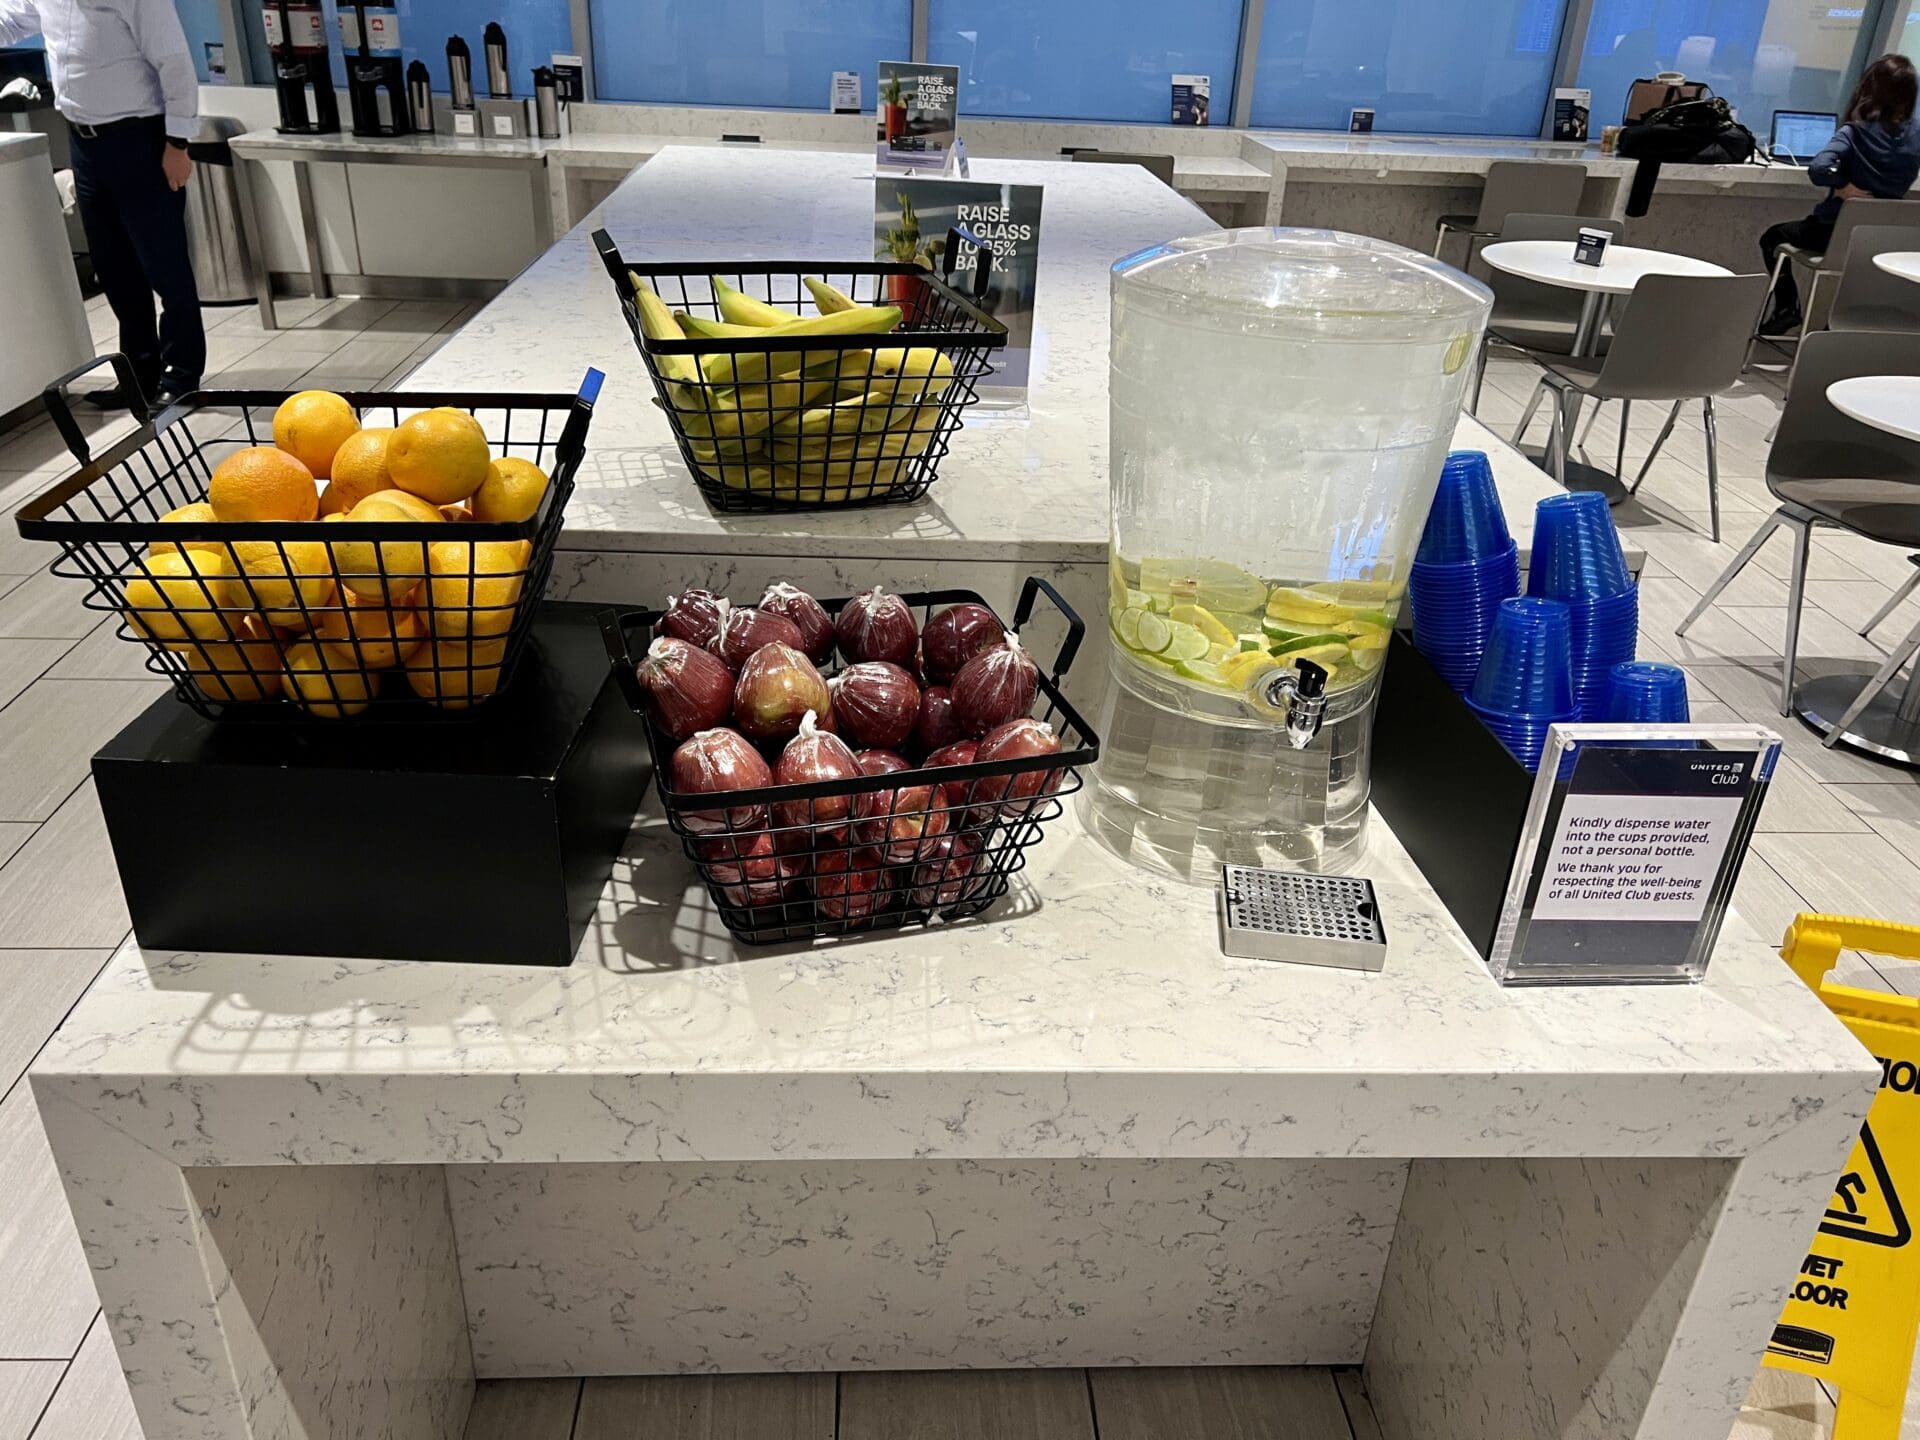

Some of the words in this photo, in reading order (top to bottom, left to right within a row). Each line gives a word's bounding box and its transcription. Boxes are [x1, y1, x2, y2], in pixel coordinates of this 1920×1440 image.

[918, 76, 944, 85] RAISE
[918, 84, 924, 92] A
[925, 85, 954, 94] GLASS
[918, 92, 929, 101] TO
[930, 93, 948, 102] 25%
[917, 101, 944, 110] BACK.
[957, 205, 1010, 222] RAISE
[973, 223, 1031, 240] GLASS
[955, 255, 1008, 272] BAK.
[1711, 773, 1739, 784] Club
[1570, 817, 1611, 829] Kindly
[1615, 817, 1670, 829] dispense
[1674, 820, 1711, 829] water
[1566, 831, 1590, 841] into
[1595, 832, 1615, 841] the
[1618, 833, 1647, 843] cups
[1649, 833, 1710, 844] provided,
[1562, 845, 1583, 854] not
[1586, 847, 1594, 855] a
[1597, 846, 1652, 856] personal
[1655, 846, 1695, 856] bottle.
[1558, 863, 1576, 872] We
[1580, 863, 1614, 873] thank
[1617, 865, 1640, 874] you
[1643, 864, 1663, 873] for
[1552, 877, 1615, 887] respecting
[1618, 877, 1637, 886] the
[1640, 877, 1702, 888] well-being
[1549, 889, 1563, 899] of
[1565, 889, 1580, 899] all
[1583, 890, 1622, 899] United
[1625, 890, 1651, 900] Club
[1653, 892, 1695, 901] guests.
[1789, 1281, 1848, 1310] OOR
